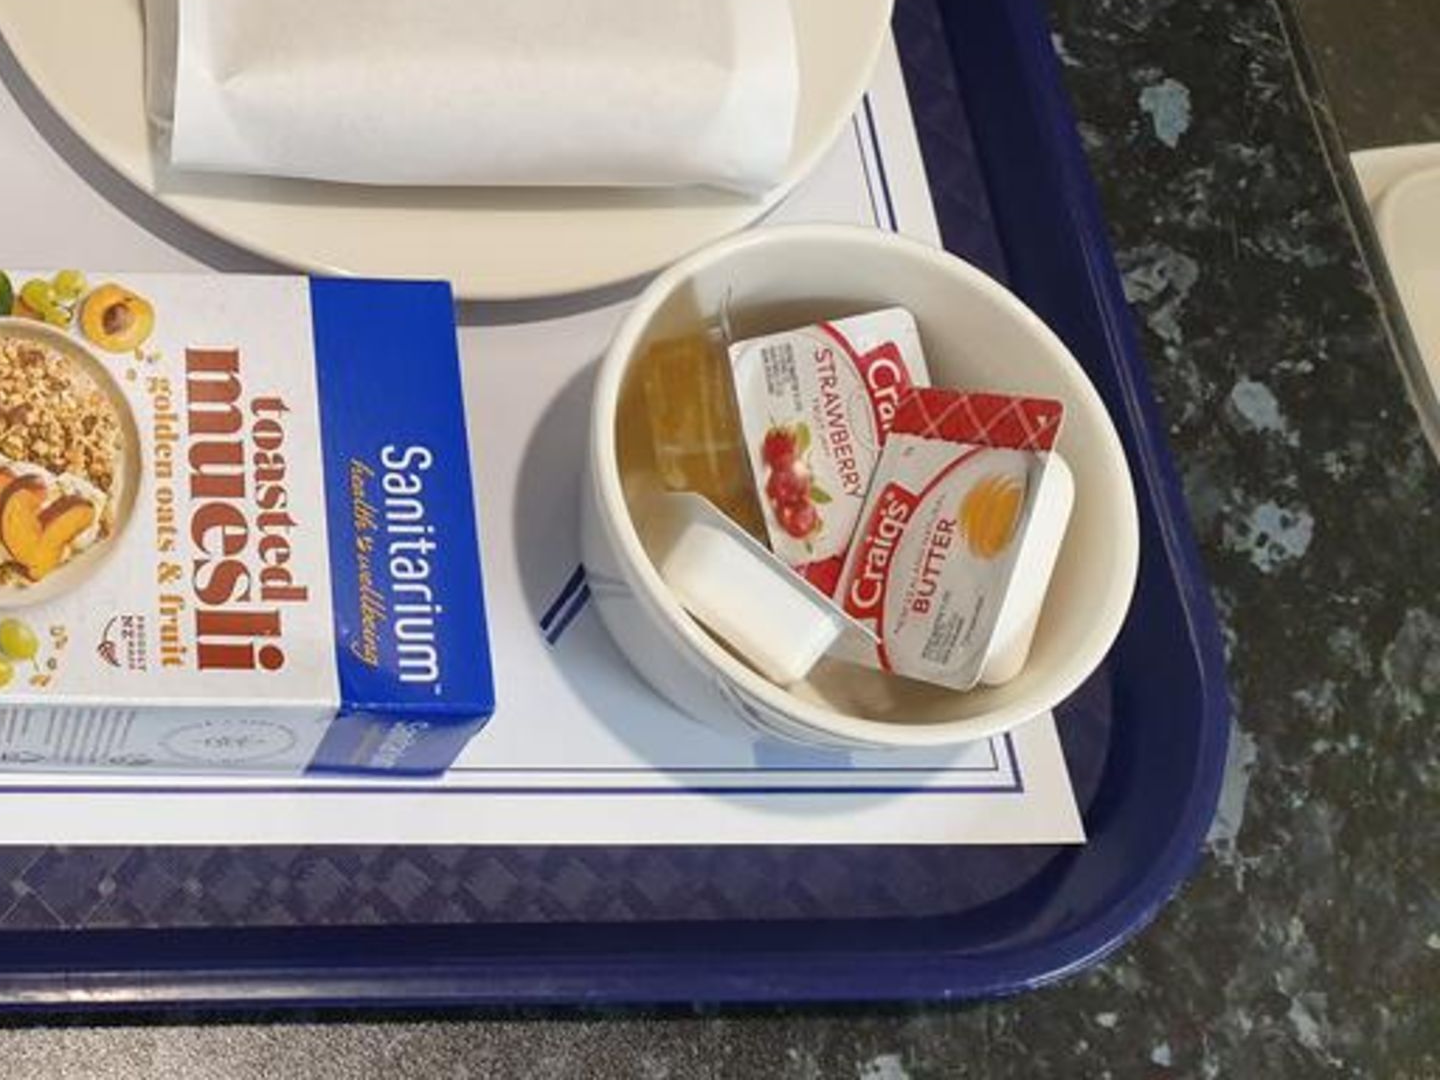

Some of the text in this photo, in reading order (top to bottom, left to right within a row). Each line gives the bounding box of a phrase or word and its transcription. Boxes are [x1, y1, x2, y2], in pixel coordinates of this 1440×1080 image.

[813, 347, 864, 499] STRAWBERRY
[867, 357, 901, 430] Cra
[146, 376, 187, 668] golden oats & fruit
[184, 347, 287, 673] muesli
[249, 394, 310, 603] toasted
[349, 458, 379, 531] health
[850, 496, 911, 610] Craig's
[350, 554, 386, 669] wellbeing
[380, 444, 443, 683] Sanitarium
[912, 518, 957, 615] BUTTER
